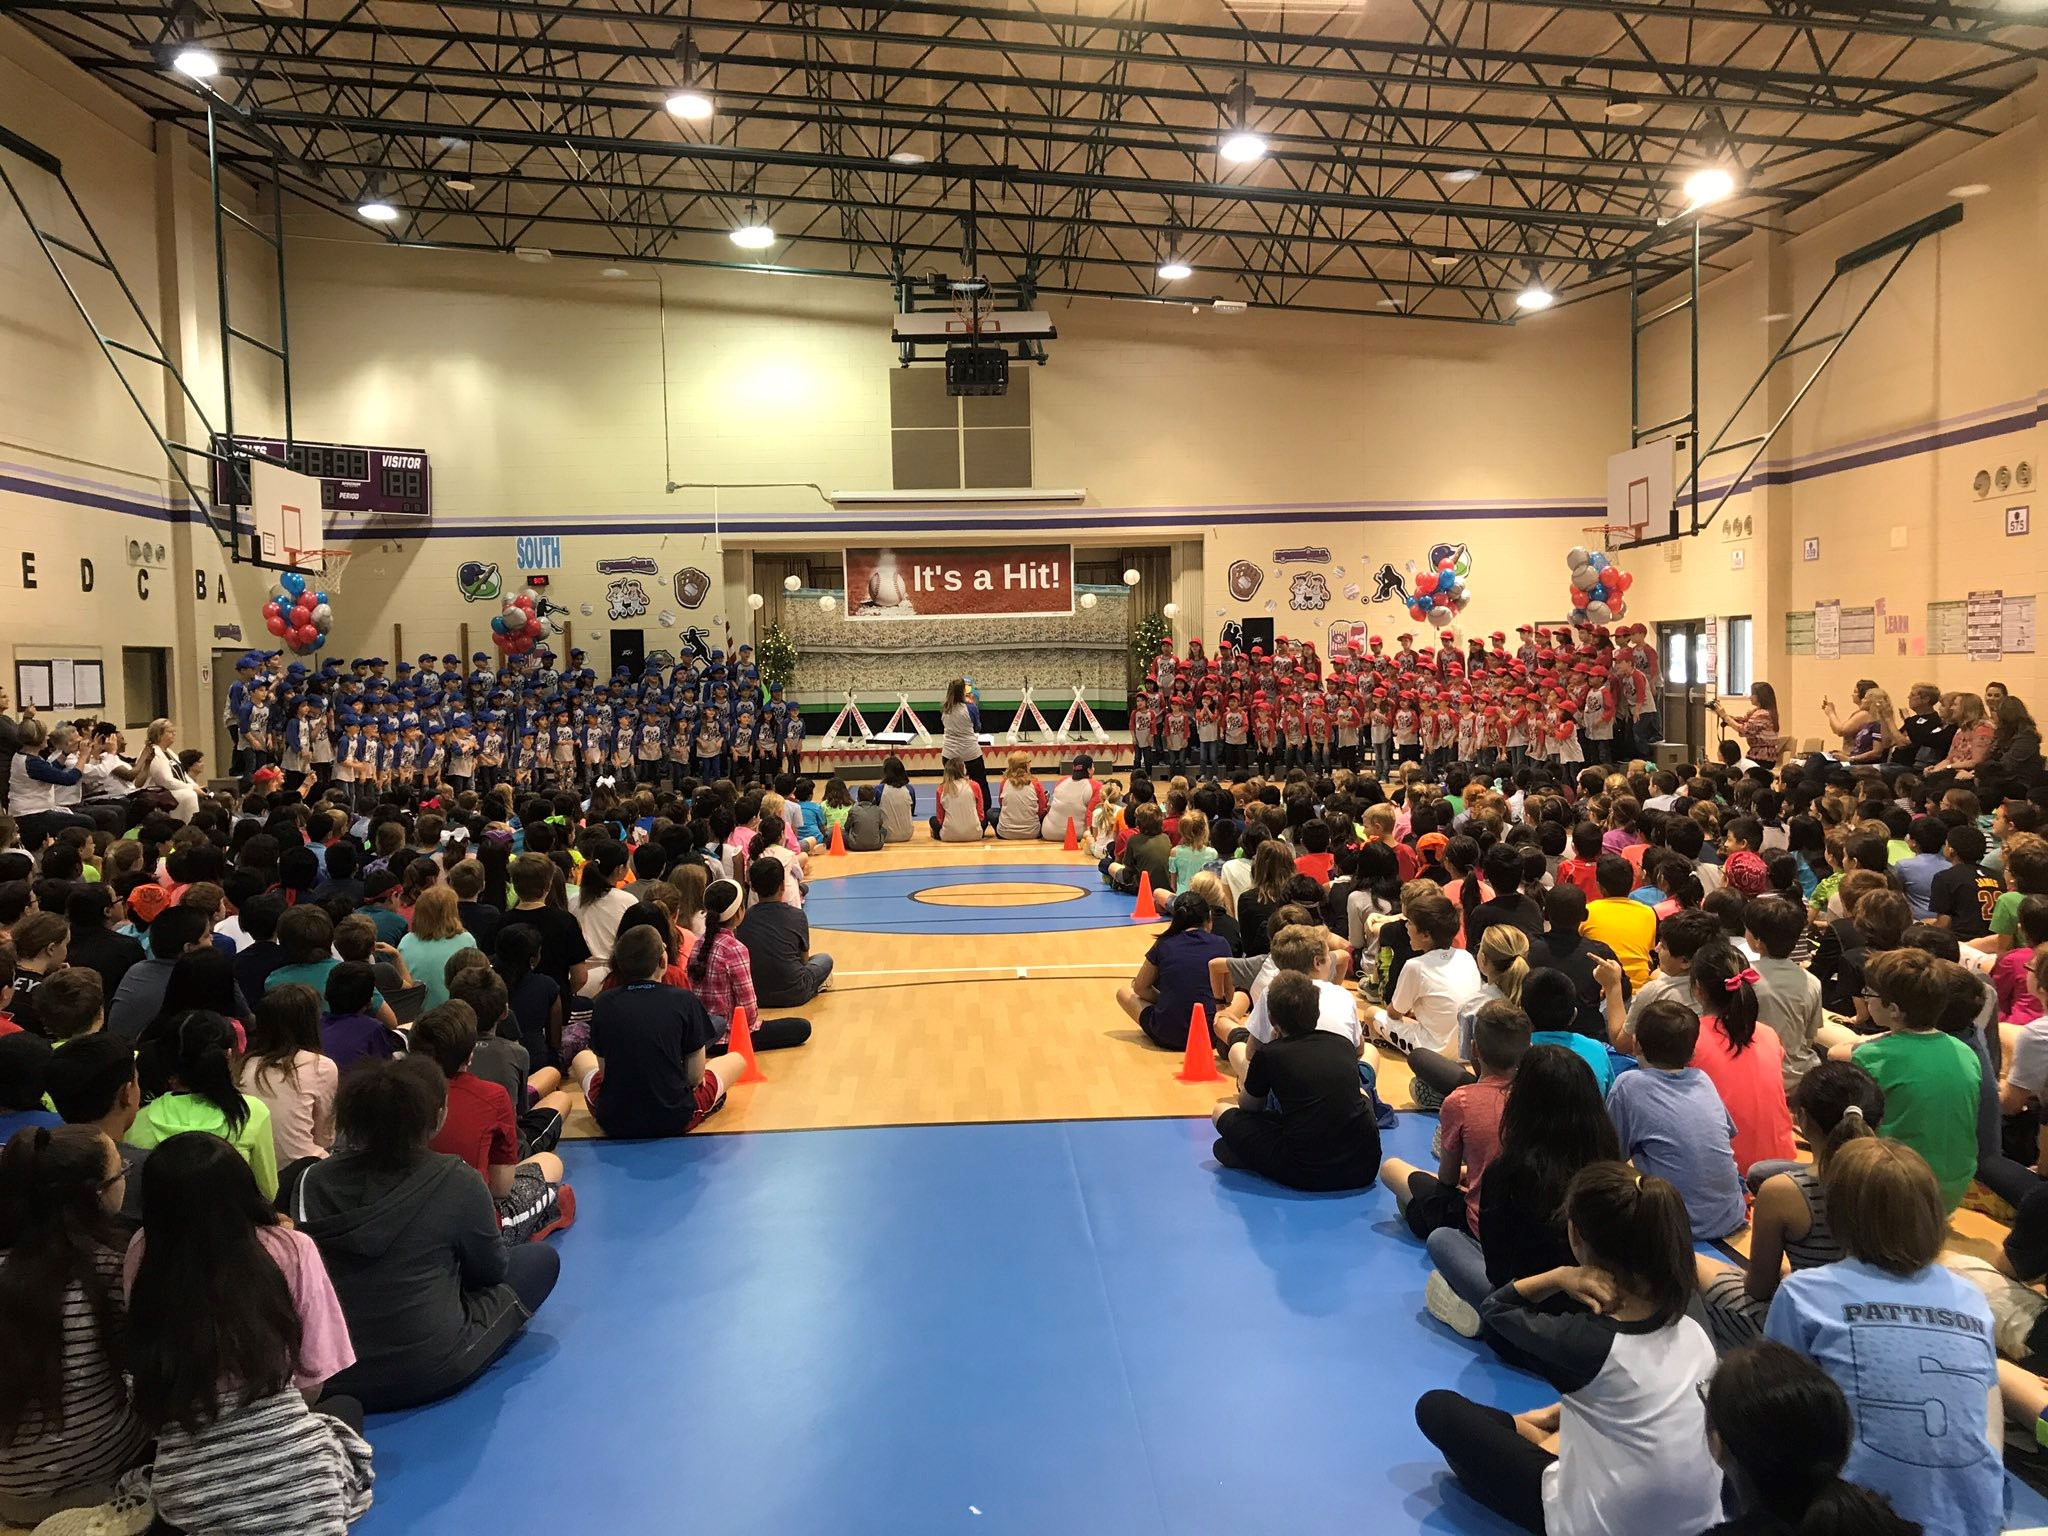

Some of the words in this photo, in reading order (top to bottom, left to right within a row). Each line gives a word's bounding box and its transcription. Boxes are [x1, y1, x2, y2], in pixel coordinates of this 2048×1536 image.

[233, 444, 268, 458] OLTS
[382, 454, 421, 469] VISITOR
[338, 492, 360, 500] PERIOD
[2010, 520, 2024, 531] 575
[517, 537, 561, 569] SOUTH
[21, 551, 38, 589] E
[80, 558, 94, 592] D
[137, 568, 149, 600] C
[195, 569, 207, 600] B
[217, 574, 227, 604] A
[913, 565, 963, 592] It's
[973, 569, 994, 591] a
[1004, 561, 1060, 590] Hit!
[13, 977, 42, 992] EY
[1843, 1302, 1987, 1334] PATTISON
[1850, 1324, 1993, 1469] 5
